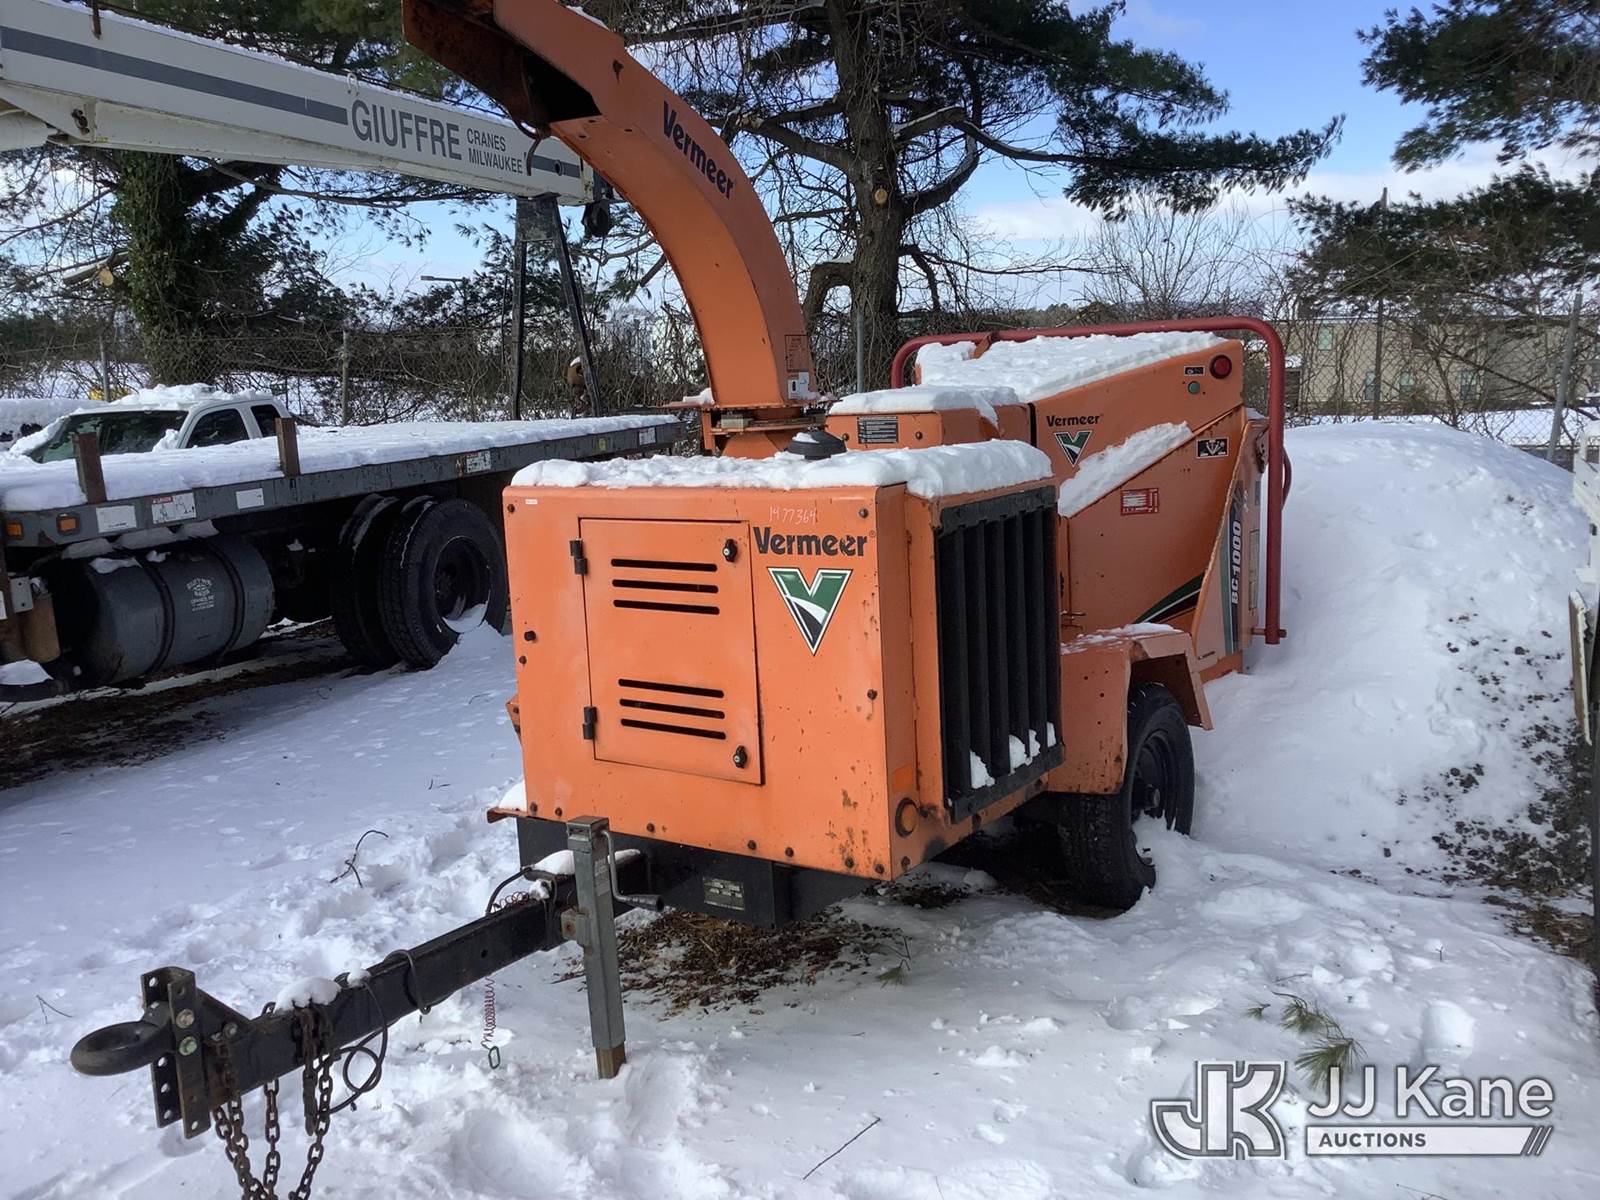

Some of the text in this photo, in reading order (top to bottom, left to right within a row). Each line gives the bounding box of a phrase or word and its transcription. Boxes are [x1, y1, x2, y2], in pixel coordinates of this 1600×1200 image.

[351, 100, 462, 161] GIUFFRE
[467, 127, 507, 152] CRANES
[468, 147, 523, 174] MILWAUKEE
[663, 100, 734, 199] Vermeer
[1046, 415, 1100, 427] Vermeer
[753, 527, 867, 556] Vermeer
[1231, 520, 1242, 605] BC1000
